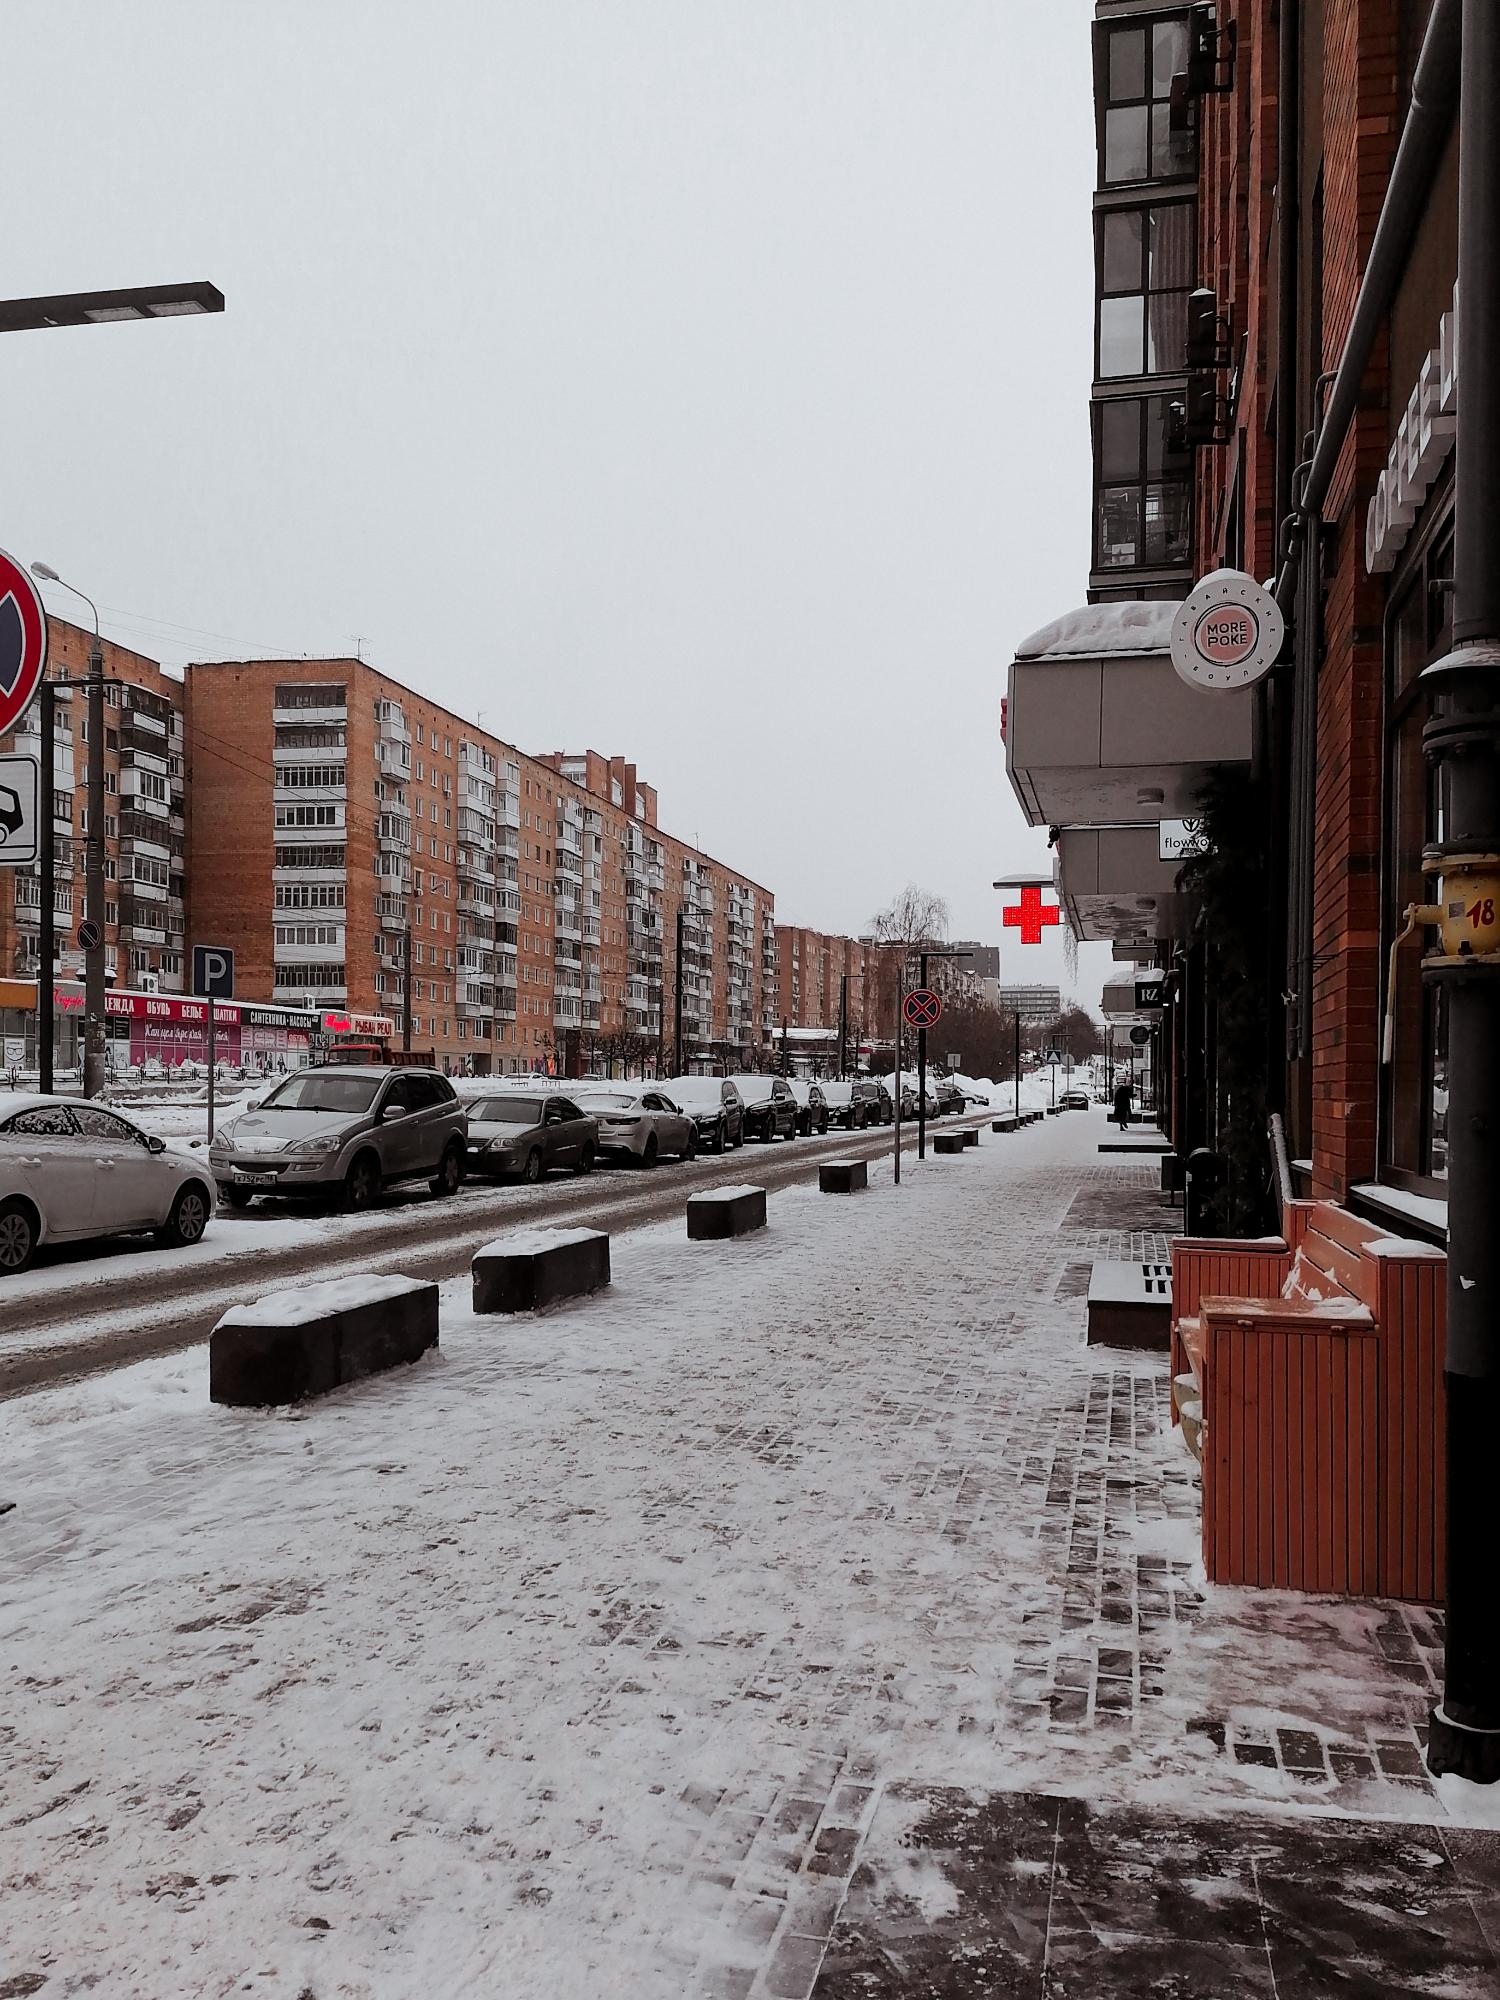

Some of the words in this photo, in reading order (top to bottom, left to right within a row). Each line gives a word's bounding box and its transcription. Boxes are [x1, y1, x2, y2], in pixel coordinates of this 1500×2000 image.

[1179, 588, 1276, 641] ГАВАЙСКИЕ
[1207, 621, 1248, 635] MORE
[1207, 634, 1248, 647] POKE
[1165, 837, 1208, 848] flowwo
[1466, 899, 1495, 928] 18
[205, 953, 227, 992] P
[1141, 989, 1158, 1002] RZ
[105, 997, 134, 1014] ДЕЖДА
[147, 1001, 171, 1016] ОБУВЬ
[181, 1004, 203, 1019] БЕЛЬЕ
[213, 1008, 237, 1022] ШАПКИ
